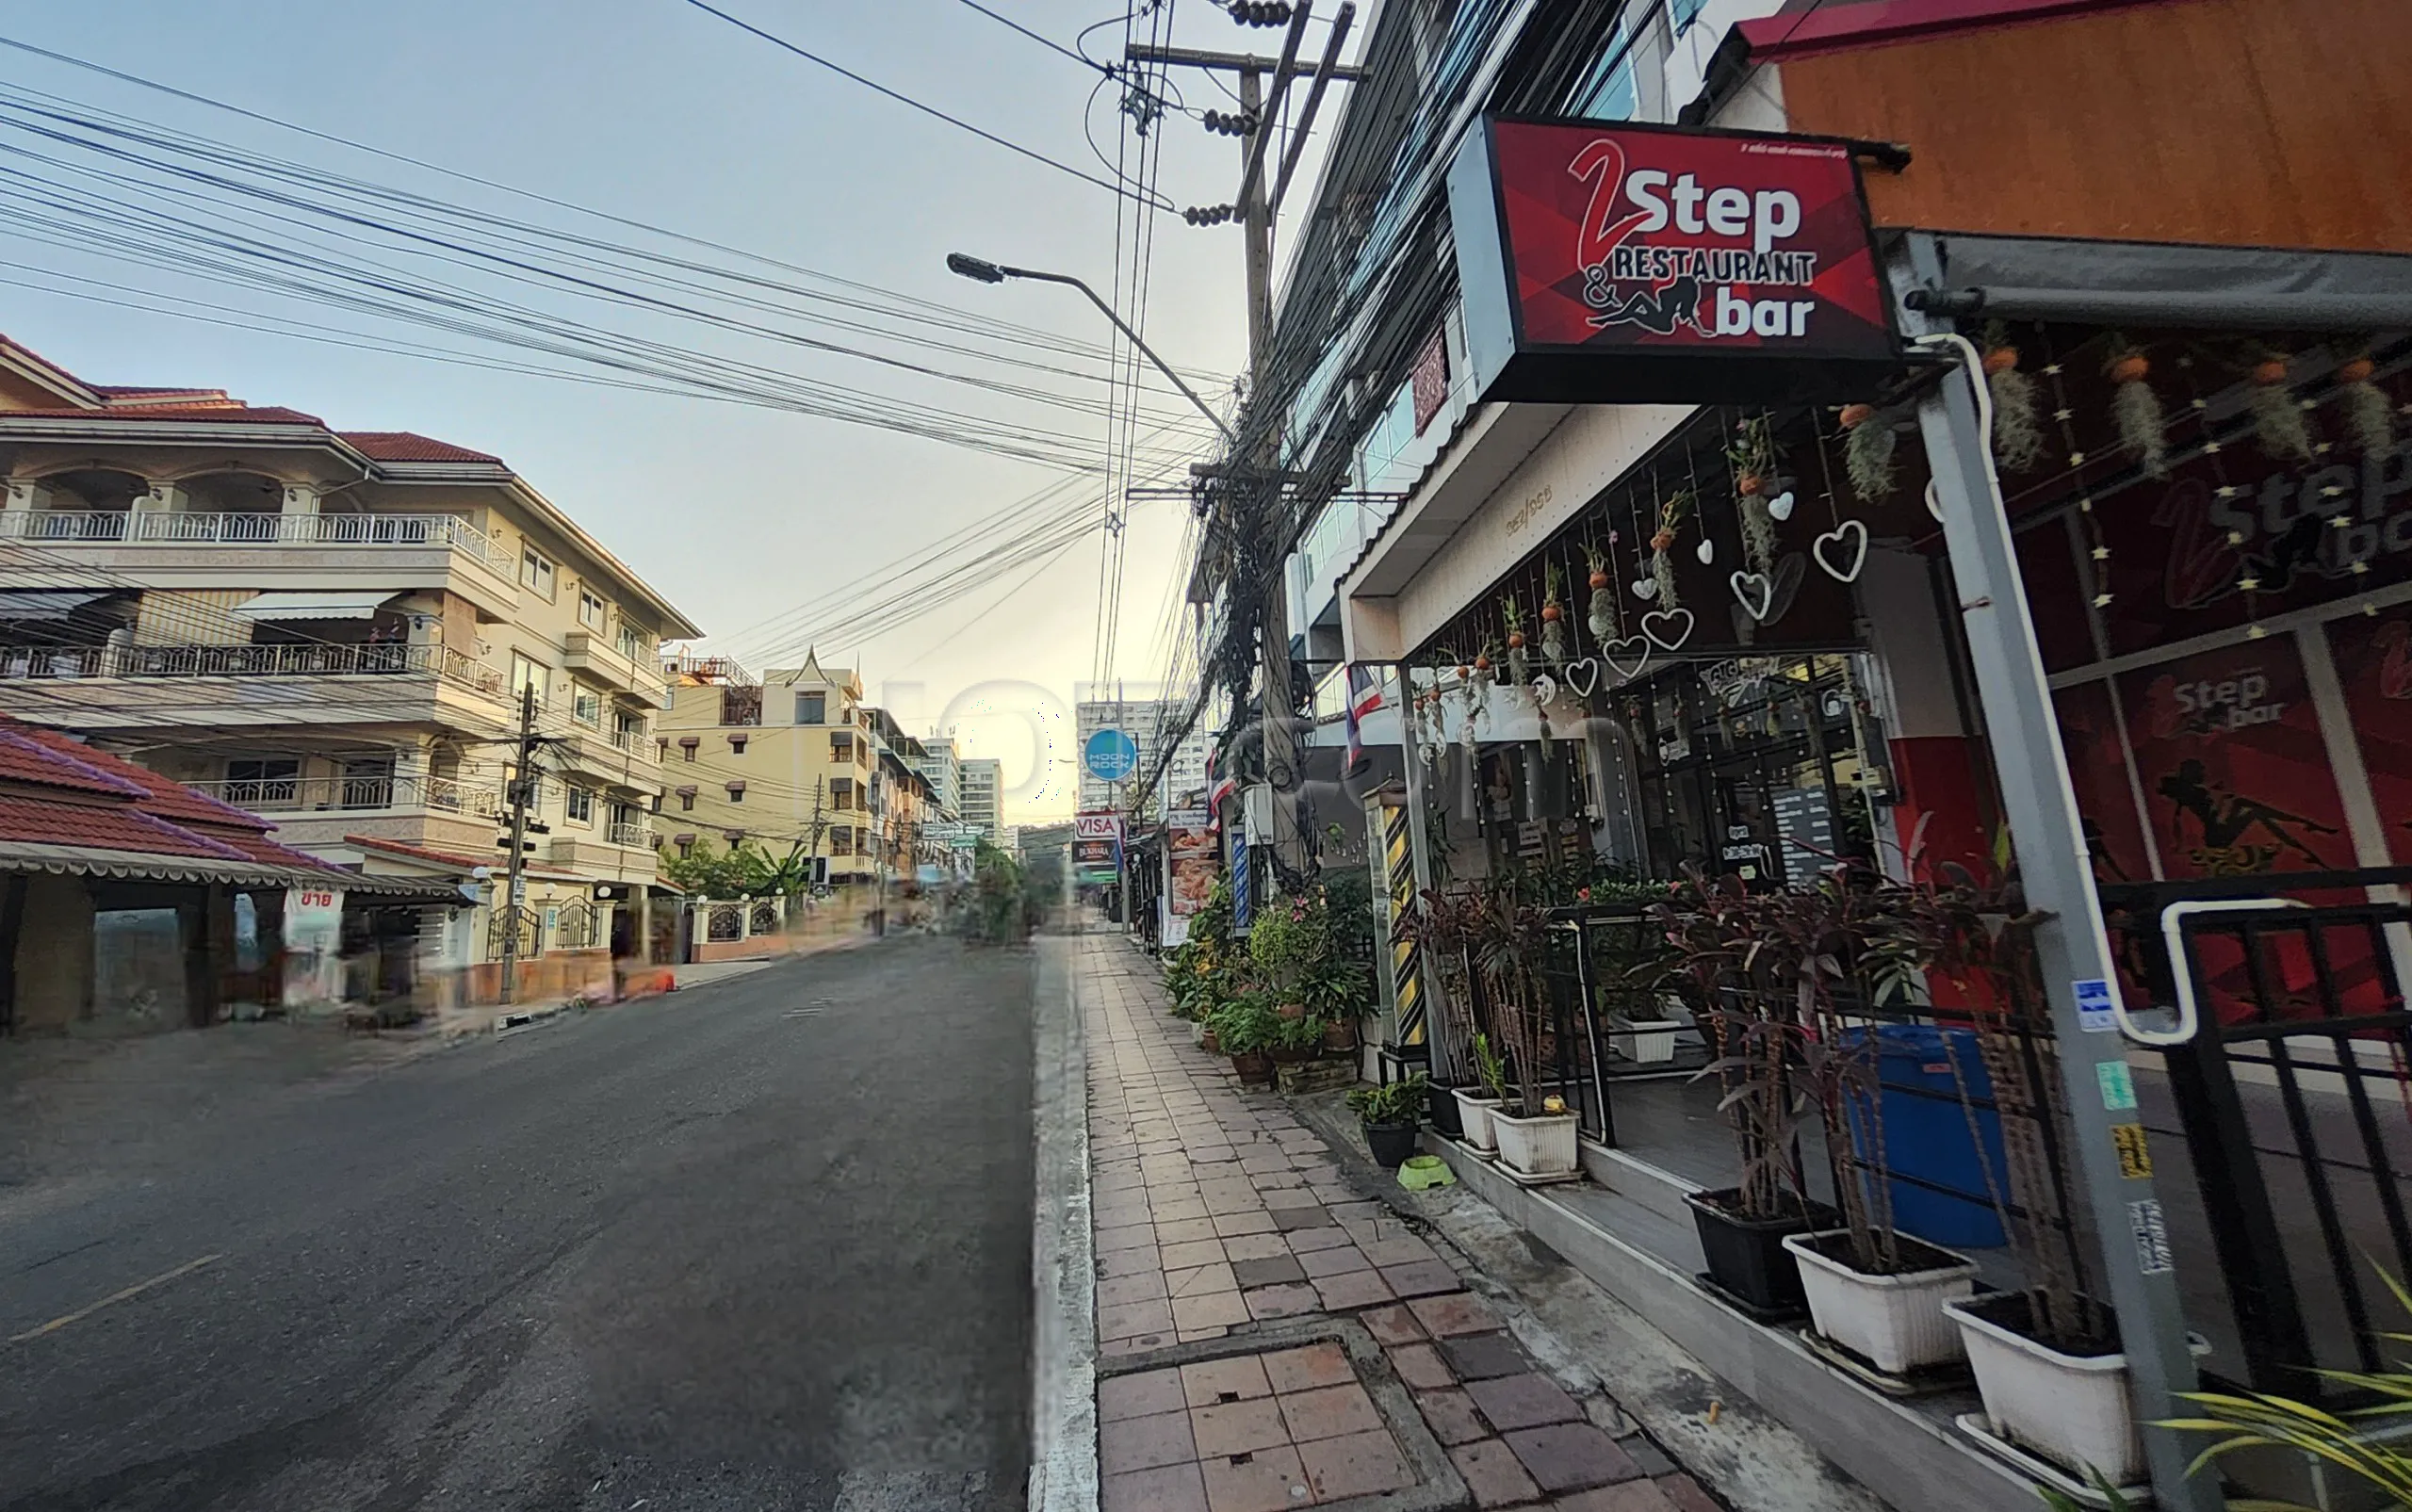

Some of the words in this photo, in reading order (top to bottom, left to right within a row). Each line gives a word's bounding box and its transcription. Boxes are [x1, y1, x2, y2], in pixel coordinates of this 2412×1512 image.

[1625, 170, 1801, 252] Step
[1614, 245, 1817, 285] RESTAURANT
[1717, 285, 1815, 337] bar
[2174, 673, 2270, 715] Step
[2226, 701, 2288, 731] bar
[1089, 753, 1131, 761] MOON
[1076, 818, 1116, 835] VISA
[301, 891, 333, 907] ขาย
